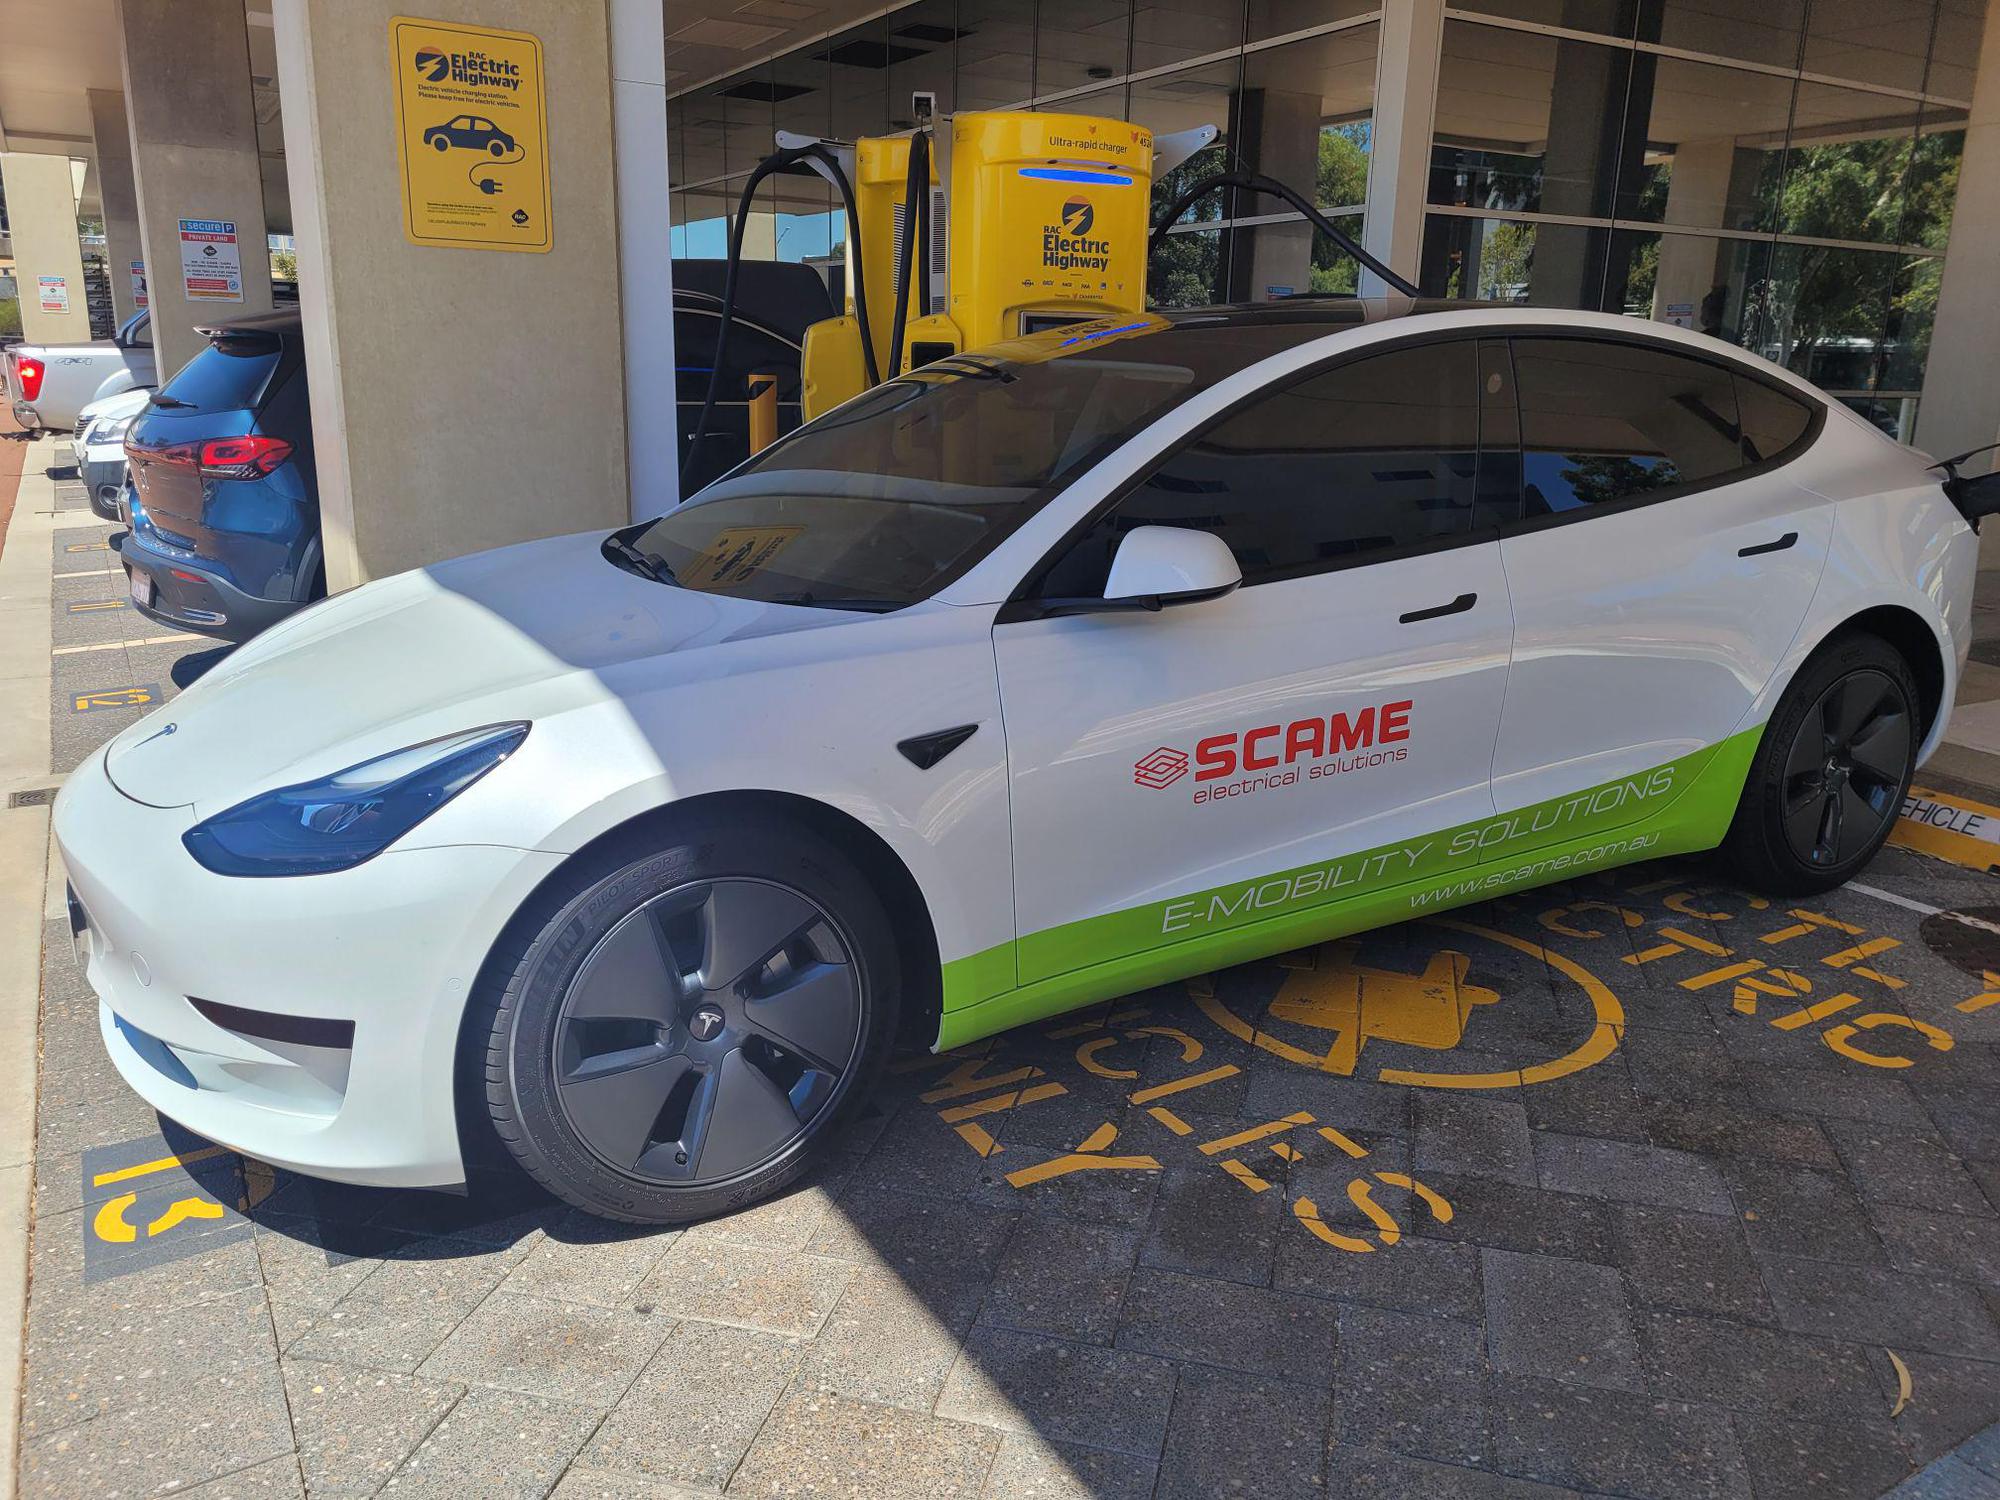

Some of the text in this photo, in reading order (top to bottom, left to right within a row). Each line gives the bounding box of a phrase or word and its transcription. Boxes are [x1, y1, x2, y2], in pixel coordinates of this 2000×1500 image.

[451, 53, 520, 76] Electric
[468, 51, 486, 61] RAC
[418, 84, 439, 93] Electric
[440, 87, 461, 95] vehicle
[461, 89, 487, 98] charging
[451, 69, 520, 92] Highway
[418, 91, 438, 99] Please
[474, 98, 496, 106] electric
[1049, 135, 1128, 154] Ultra-rapid charger
[187, 221, 221, 232] secure
[188, 233, 212, 241] PRIVATE
[1043, 225, 1062, 235] RAC
[1043, 234, 1110, 255] Electric
[1043, 251, 1109, 273] Highway
[1194, 699, 1414, 783] SCAME
[1192, 747, 1409, 805] electrical solutions
[1900, 796, 1987, 837] EHICLE
[1161, 765, 1677, 934] E-MOBILITY SOLUTIONS
[631, 853, 683, 885] SPORT
[1409, 831, 1662, 909] www.scame.com.au
